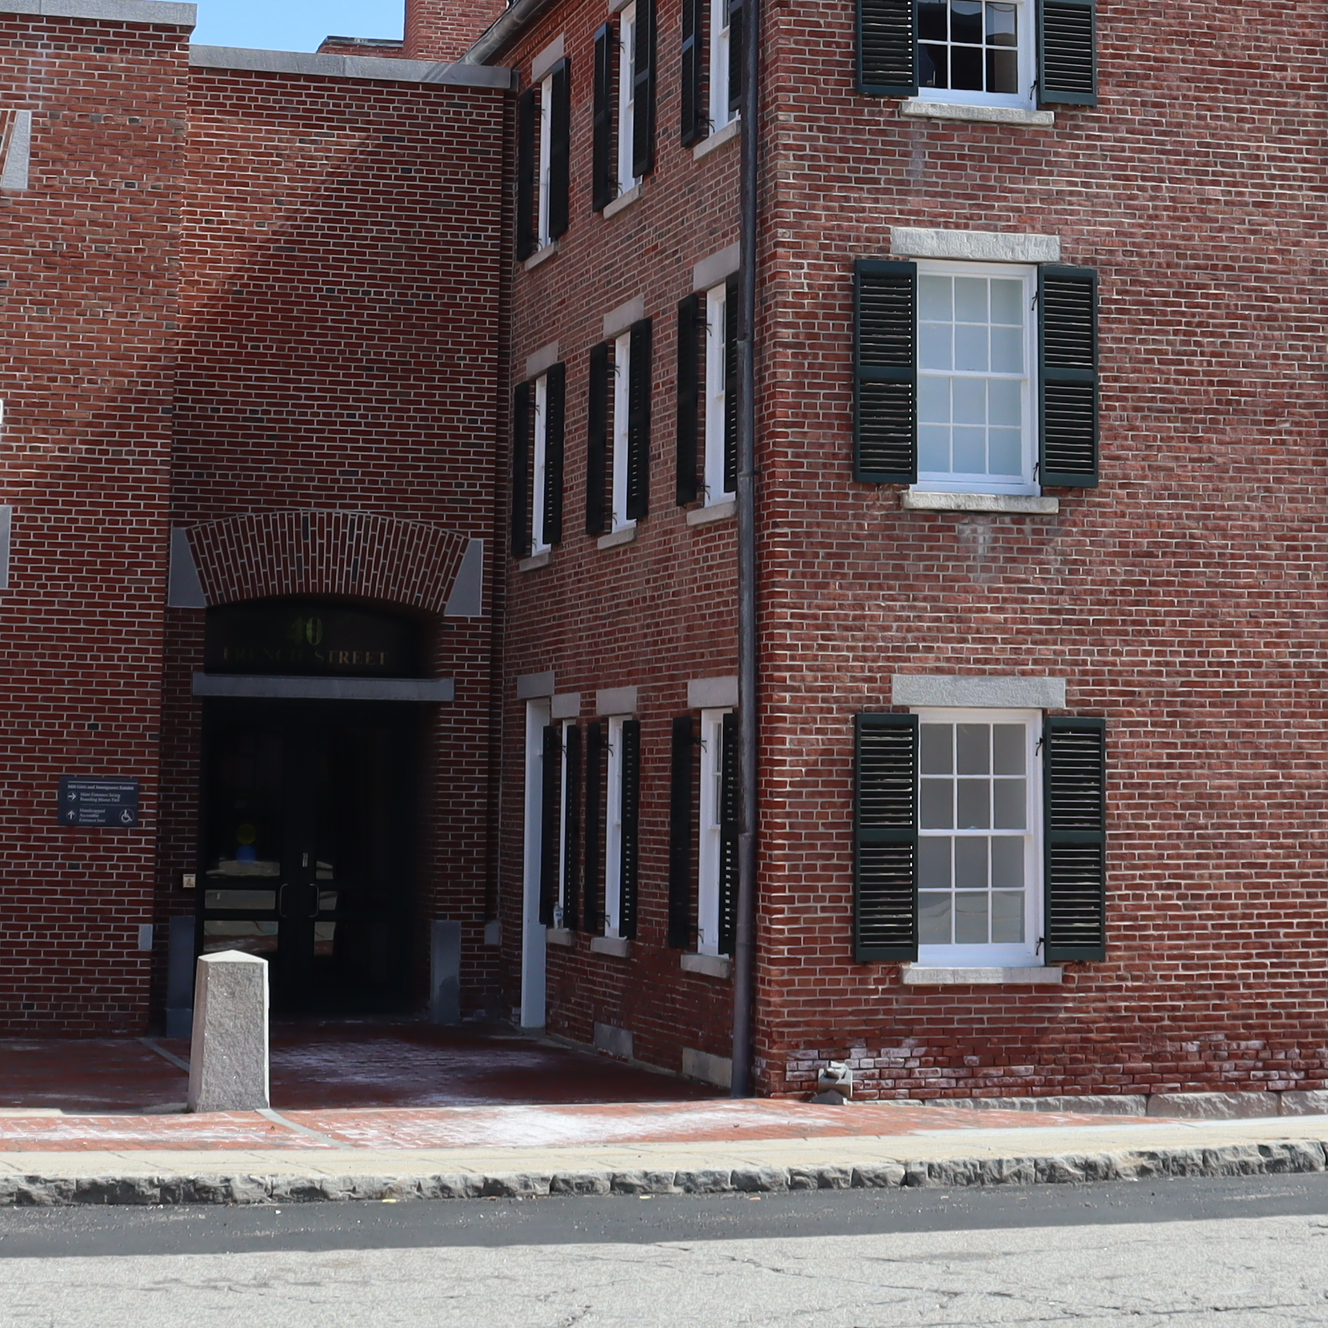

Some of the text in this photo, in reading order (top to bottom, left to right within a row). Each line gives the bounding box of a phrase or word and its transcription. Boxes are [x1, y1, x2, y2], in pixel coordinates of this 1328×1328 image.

[286, 616, 324, 647] 40
[223, 646, 389, 666] FRENCH STREET
